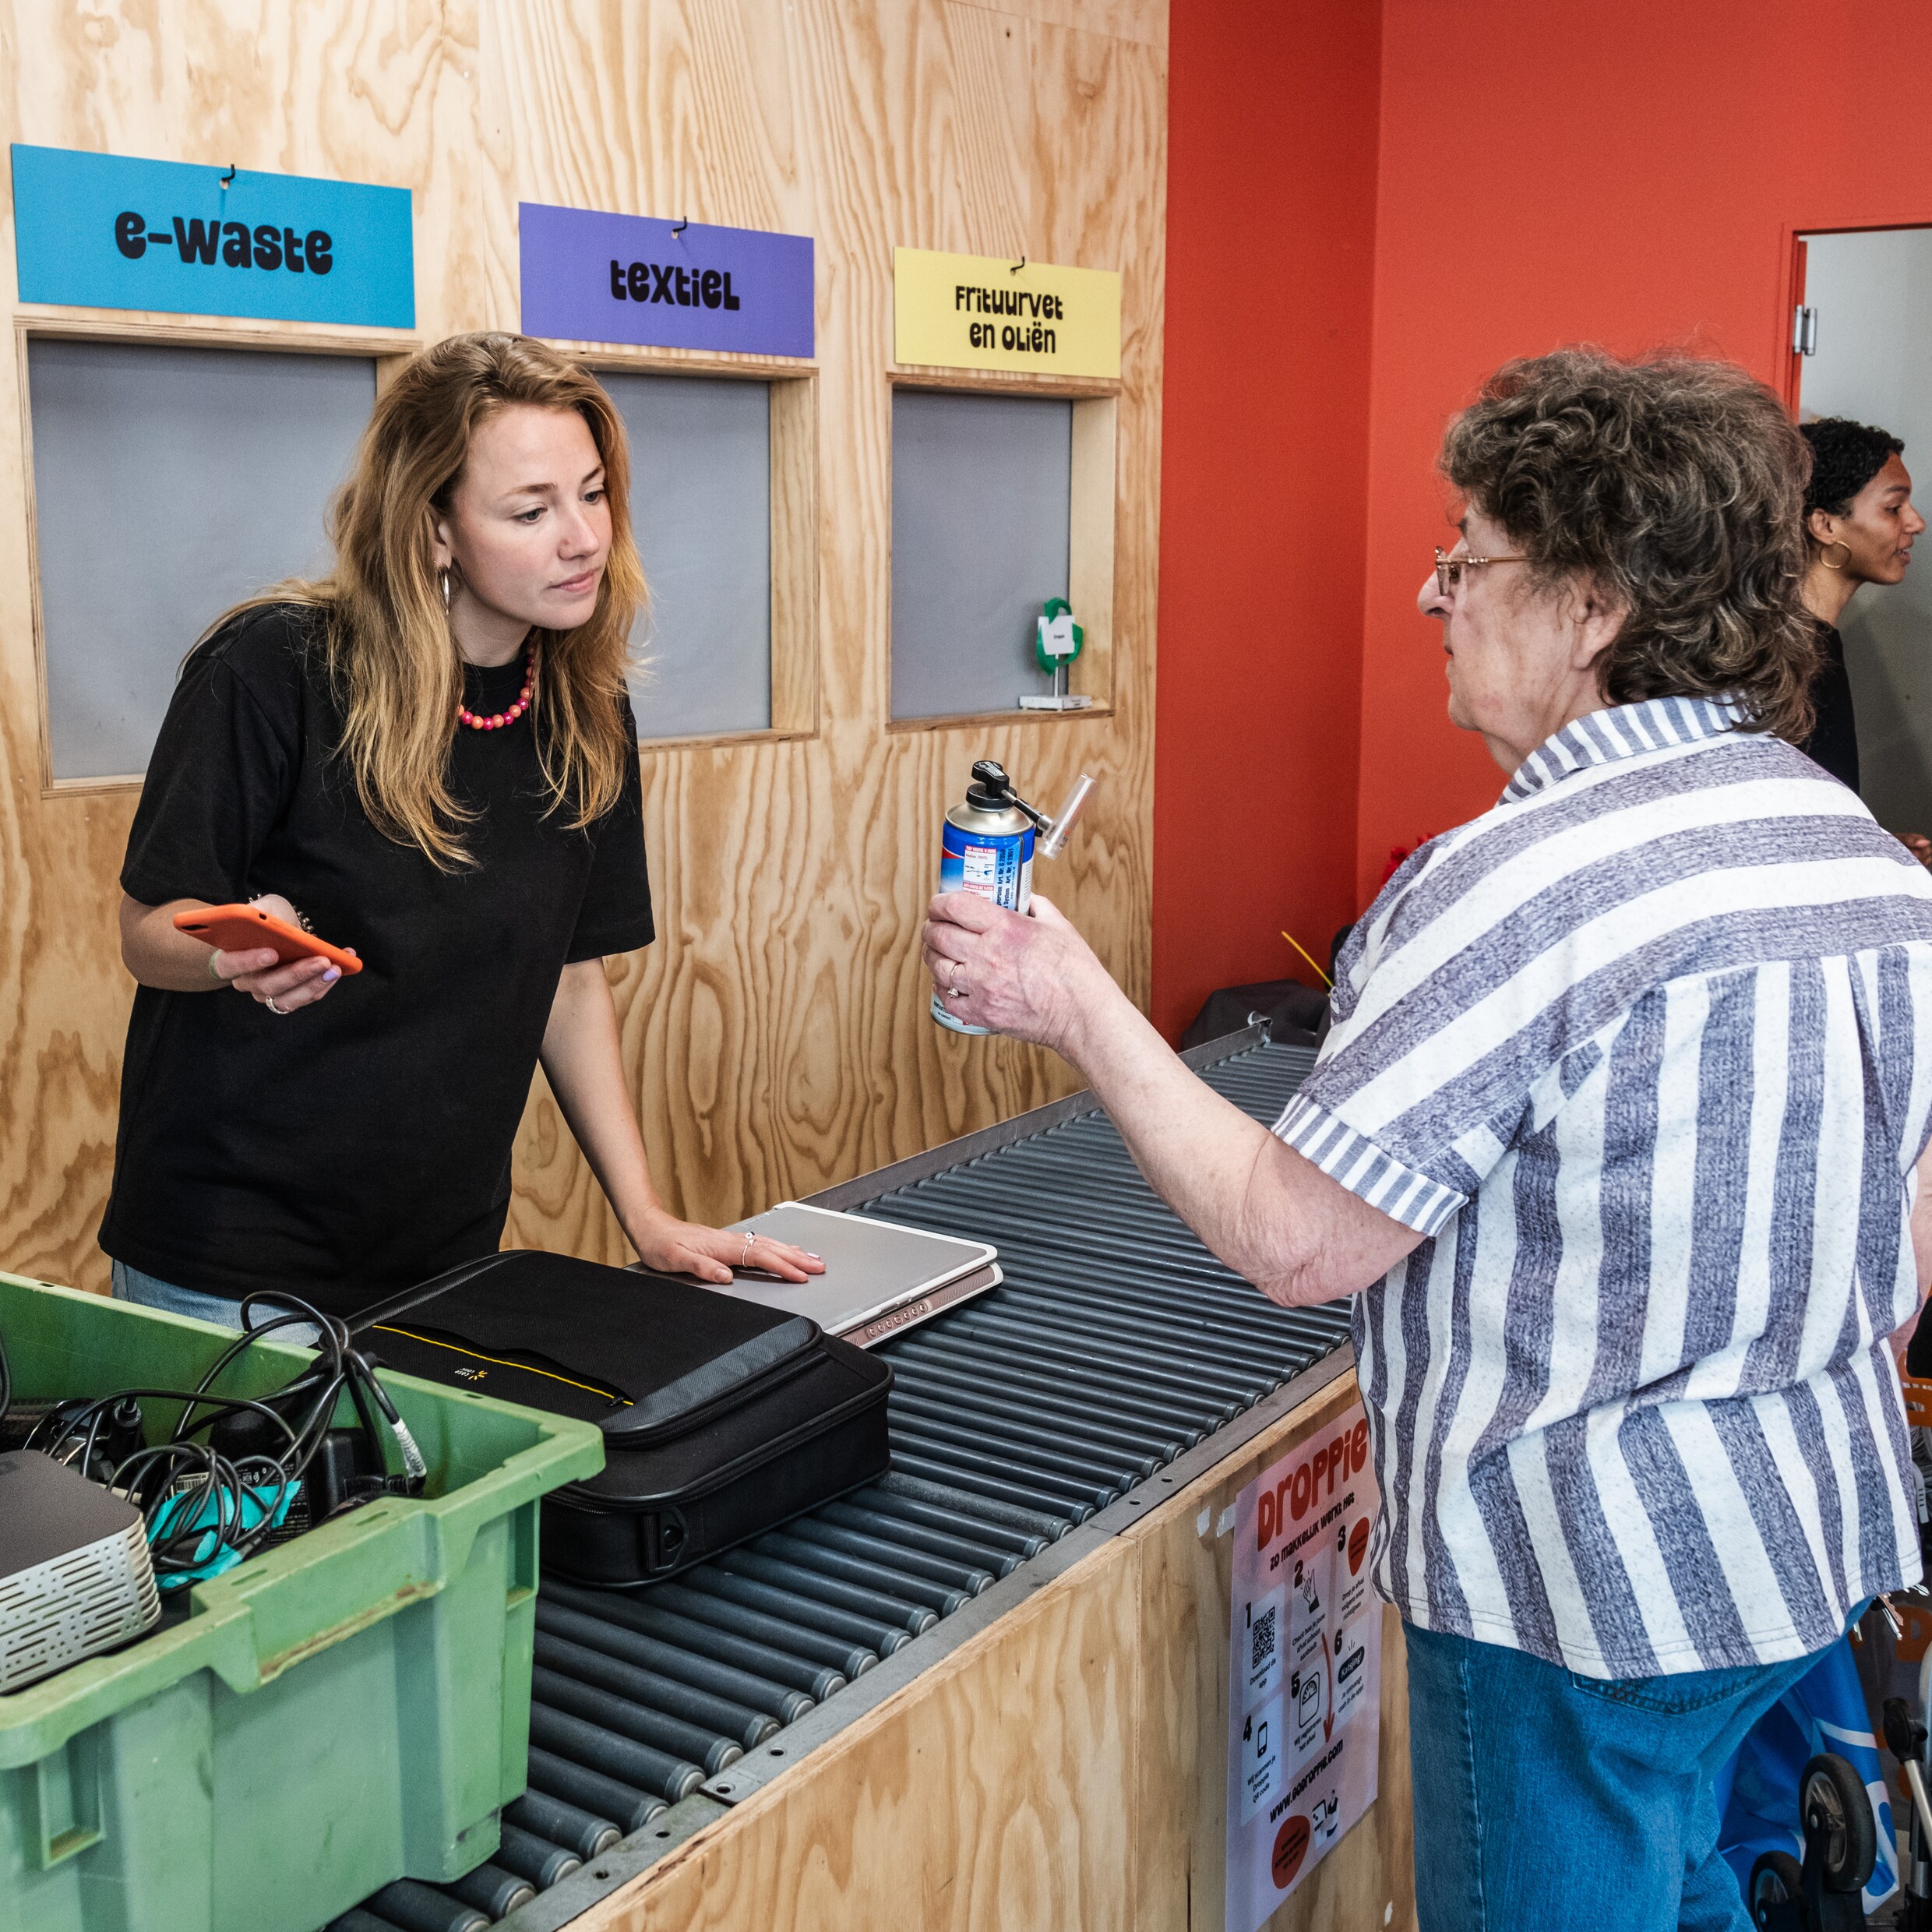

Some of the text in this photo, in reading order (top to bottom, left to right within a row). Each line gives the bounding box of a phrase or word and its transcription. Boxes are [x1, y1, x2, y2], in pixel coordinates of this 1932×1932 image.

[115, 211, 333, 276] e-waste
[969, 322, 996, 349] en
[1337, 1525, 1345, 1551] 3
[1294, 1560, 1303, 1588] 2
[1341, 1577, 1363, 1600] Drop je afval
[1341, 1588, 1364, 1611] volgens onze
[1245, 1602, 1251, 1628] 1
[1292, 1628, 1307, 1645] Check
[1312, 1621, 1316, 1630] je
[1316, 1613, 1325, 1627] jouw
[1296, 1628, 1320, 1653] afval schoon
[1334, 1628, 1342, 1655] 6
[1250, 1662, 1270, 1685] Download
[1340, 1650, 1363, 1680] Katsjing!
[1258, 1678, 1267, 1688] app
[1291, 1670, 1299, 1698] 5
[1338, 1701, 1346, 1712] cash
[1243, 1715, 1251, 1741] 4
[1306, 1731, 1315, 1745] afval
[1254, 1759, 1271, 1779] scannen
[1271, 1754, 1275, 1764] je
[1252, 1772, 1268, 1792] Droppie
[1253, 1782, 1269, 1803] QR code
